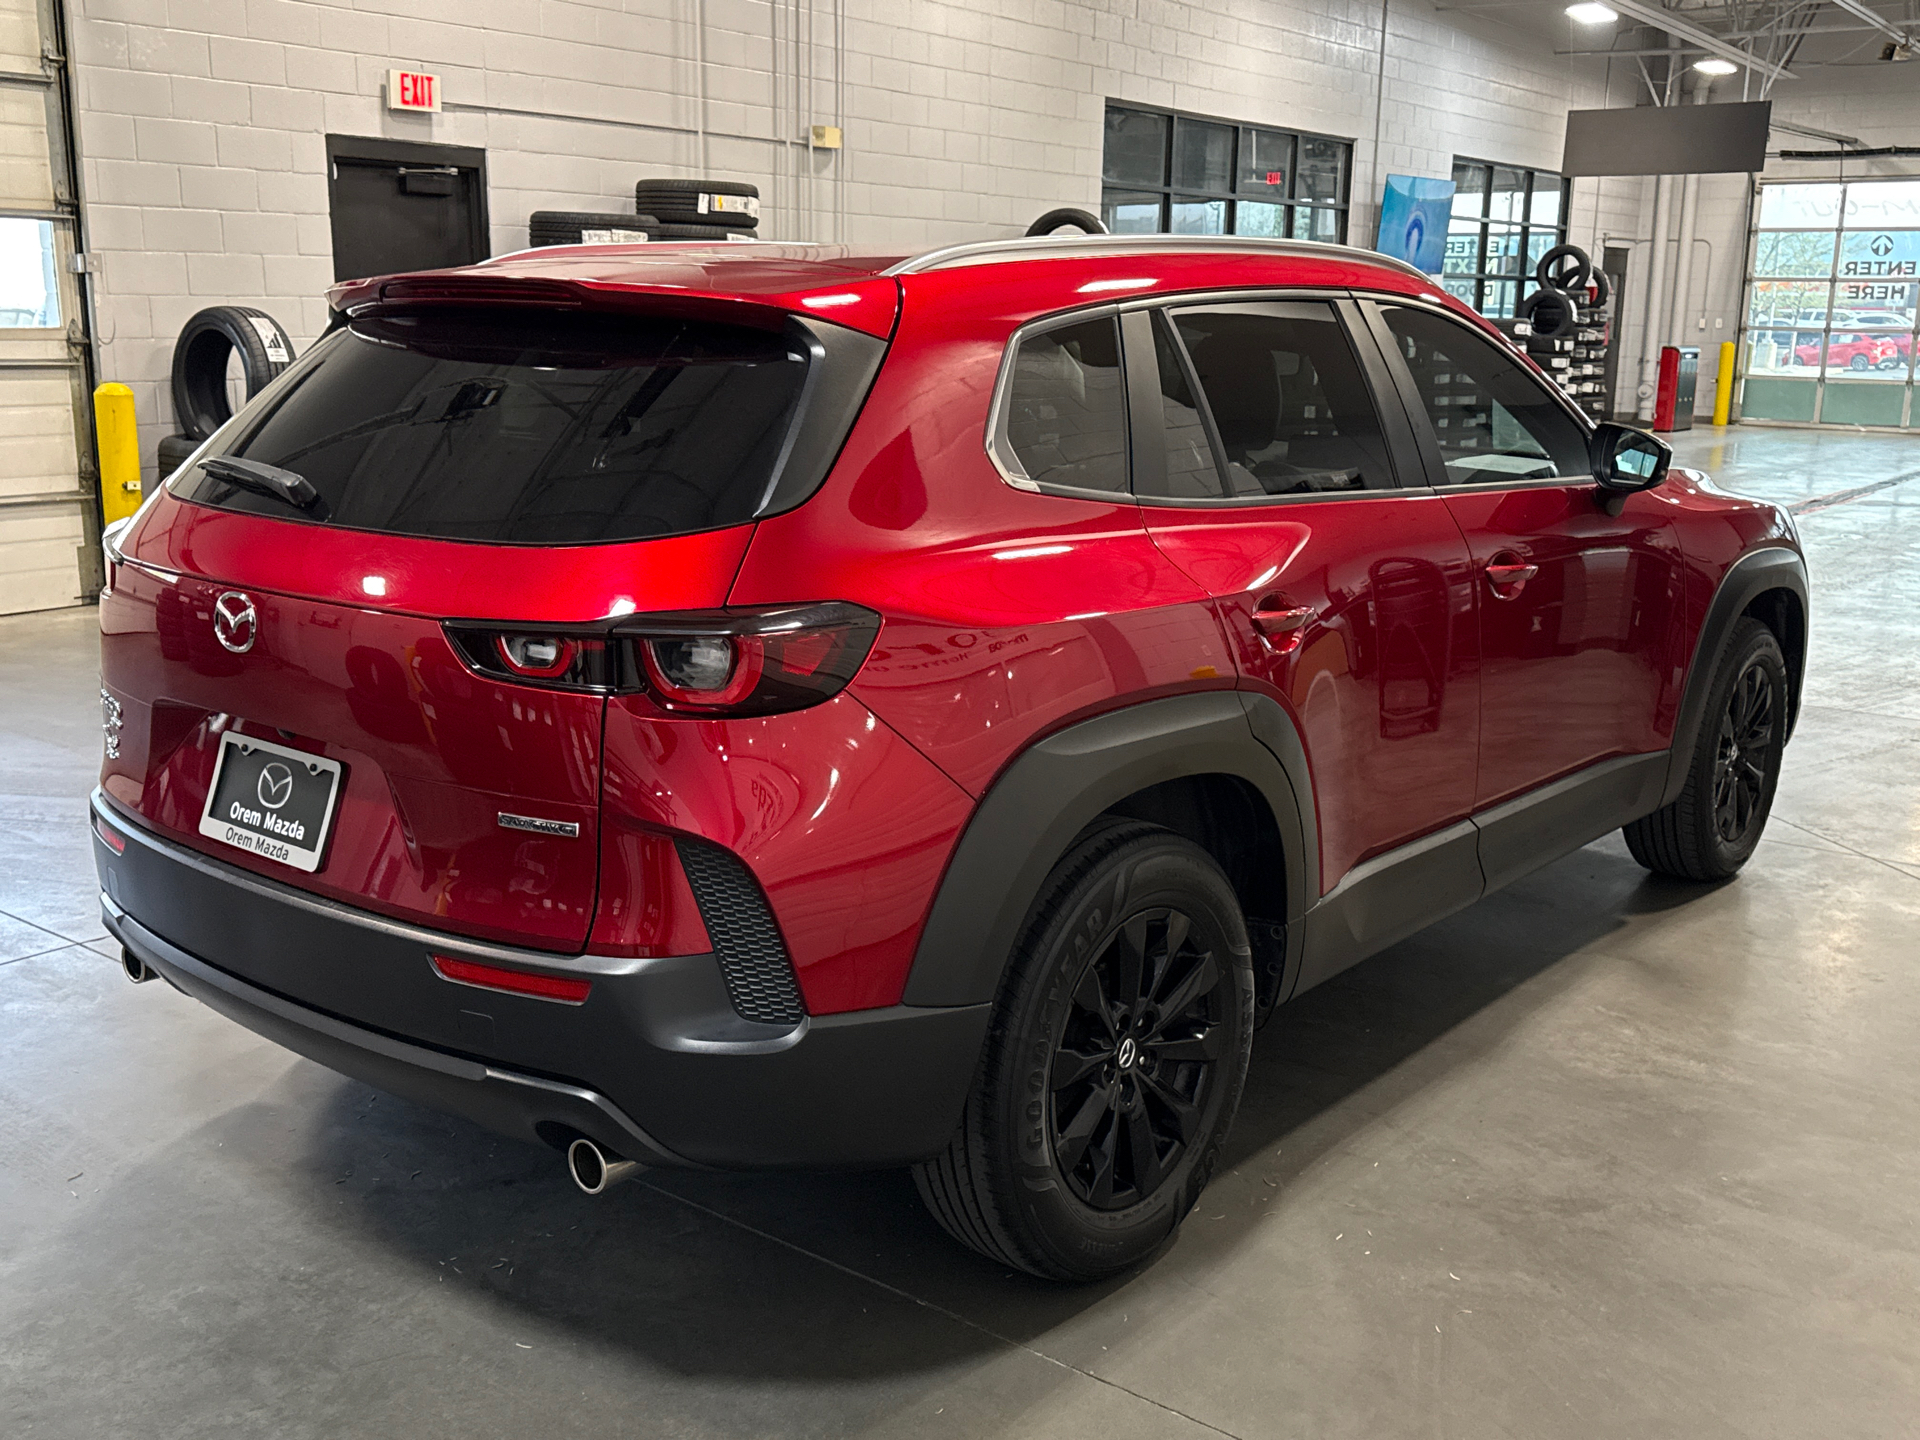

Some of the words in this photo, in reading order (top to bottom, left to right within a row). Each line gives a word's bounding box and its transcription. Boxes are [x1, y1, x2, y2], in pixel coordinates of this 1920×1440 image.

[400, 73, 434, 108] EXIT
[230, 801, 261, 827] Orem
[263, 811, 305, 840] Mazda
[225, 827, 253, 849] Orem
[254, 836, 289, 861] Mazda
